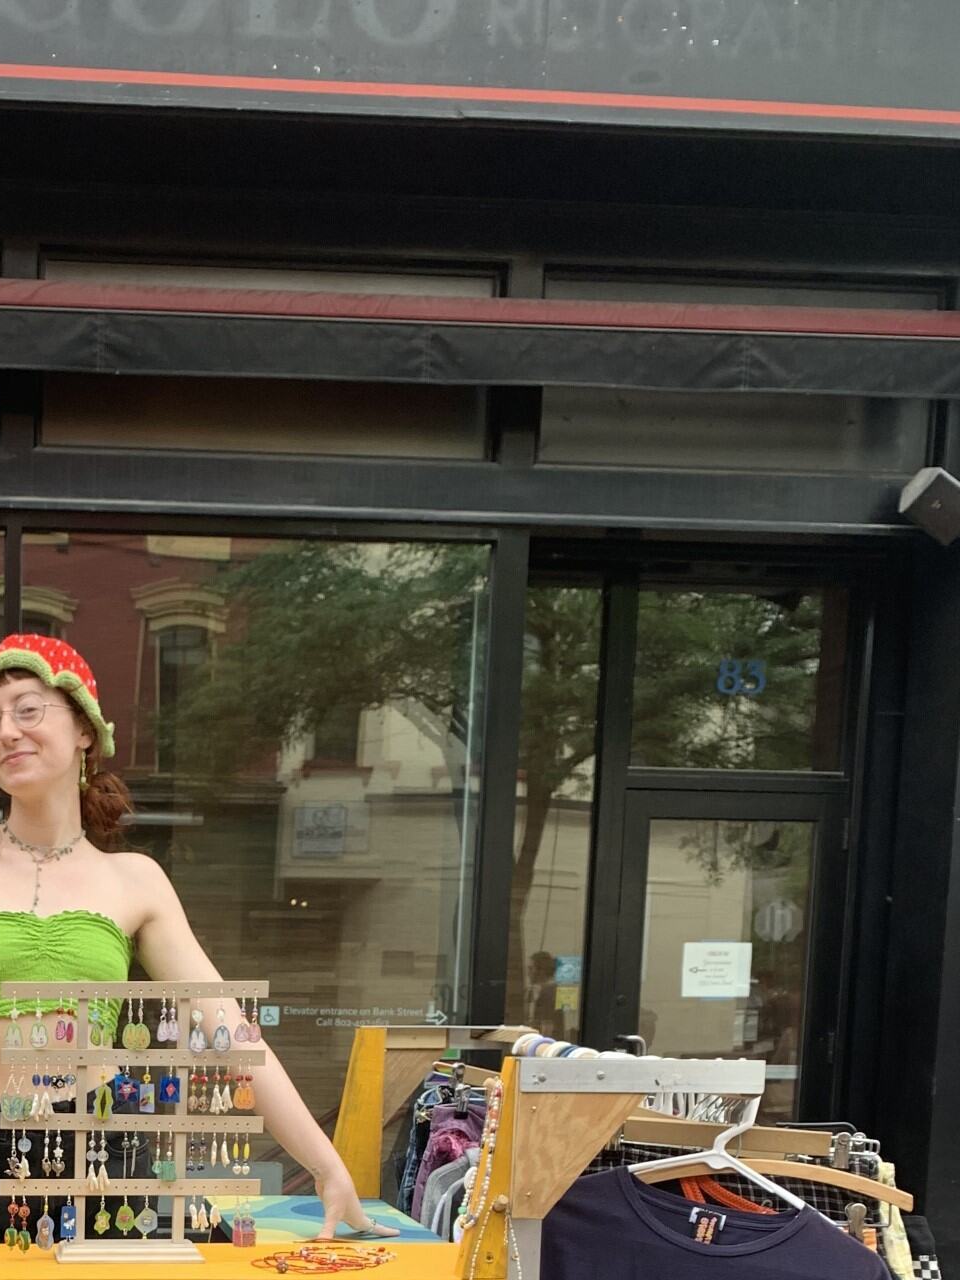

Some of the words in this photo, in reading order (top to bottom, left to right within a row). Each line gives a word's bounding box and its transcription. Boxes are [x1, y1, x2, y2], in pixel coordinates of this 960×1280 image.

[717, 659, 767, 696] 83
[284, 1006, 318, 1016] Elevator
[320, 1007, 358, 1016] entrance
[360, 1008, 371, 1016] on
[373, 1007, 395, 1016] Bank
[397, 1007, 424, 1017] Street
[316, 1018, 333, 1026] Call
